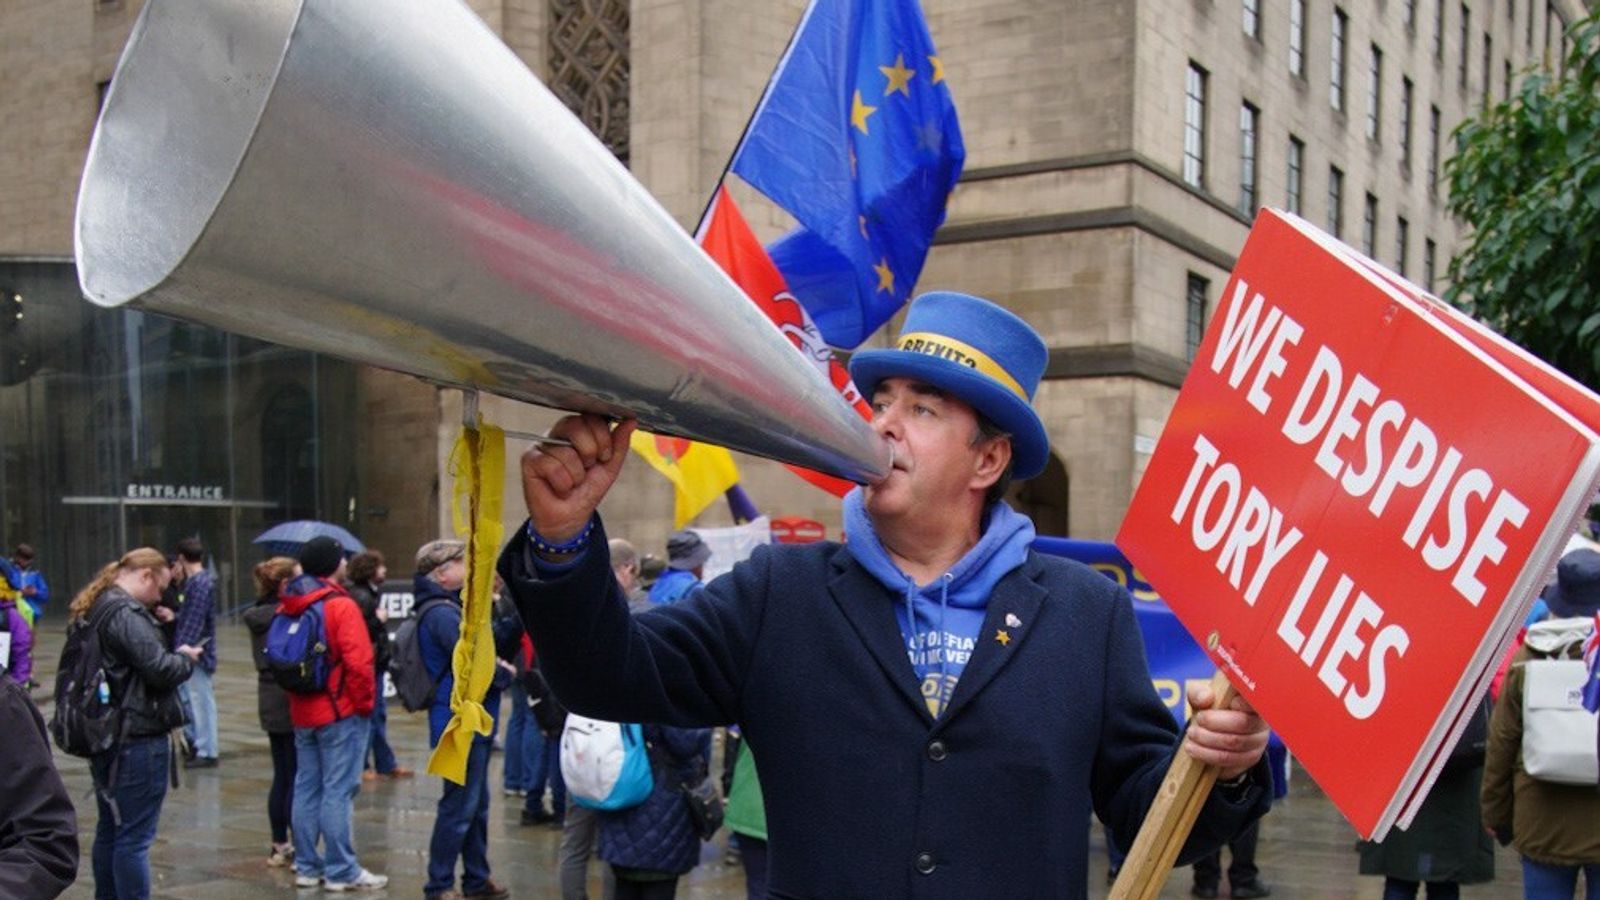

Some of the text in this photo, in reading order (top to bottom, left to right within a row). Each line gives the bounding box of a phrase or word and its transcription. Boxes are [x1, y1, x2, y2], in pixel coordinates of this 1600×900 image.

[127, 484, 223, 499] ENTRANCE
[1171, 433, 1410, 720] TORY LIES
[1211, 280, 1530, 607] WE DESPISE
